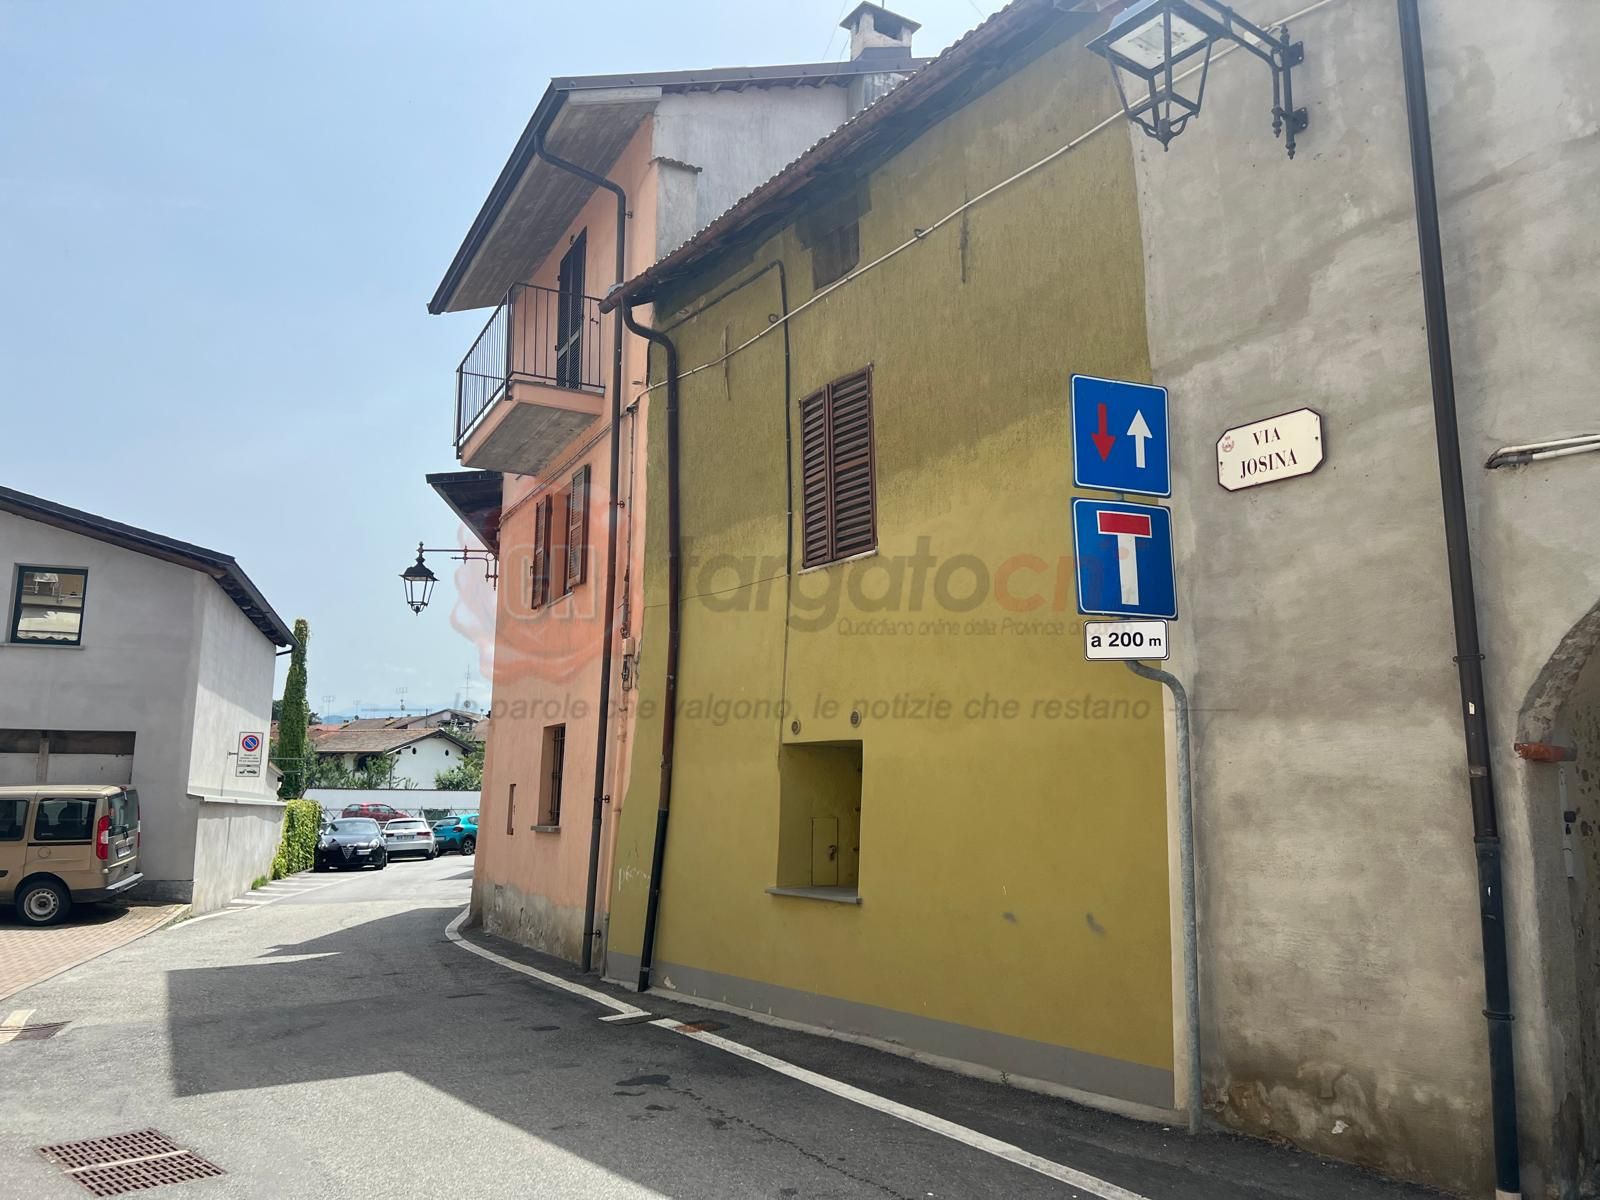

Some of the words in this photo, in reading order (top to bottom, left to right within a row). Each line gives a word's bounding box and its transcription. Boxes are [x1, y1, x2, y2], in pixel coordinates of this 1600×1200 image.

[1252, 427, 1281, 446] VIA
[1240, 448, 1298, 479] JOSINA
[1090, 635, 1102, 648] a
[1108, 632, 1144, 648] 200
[1149, 637, 1162, 647] m
